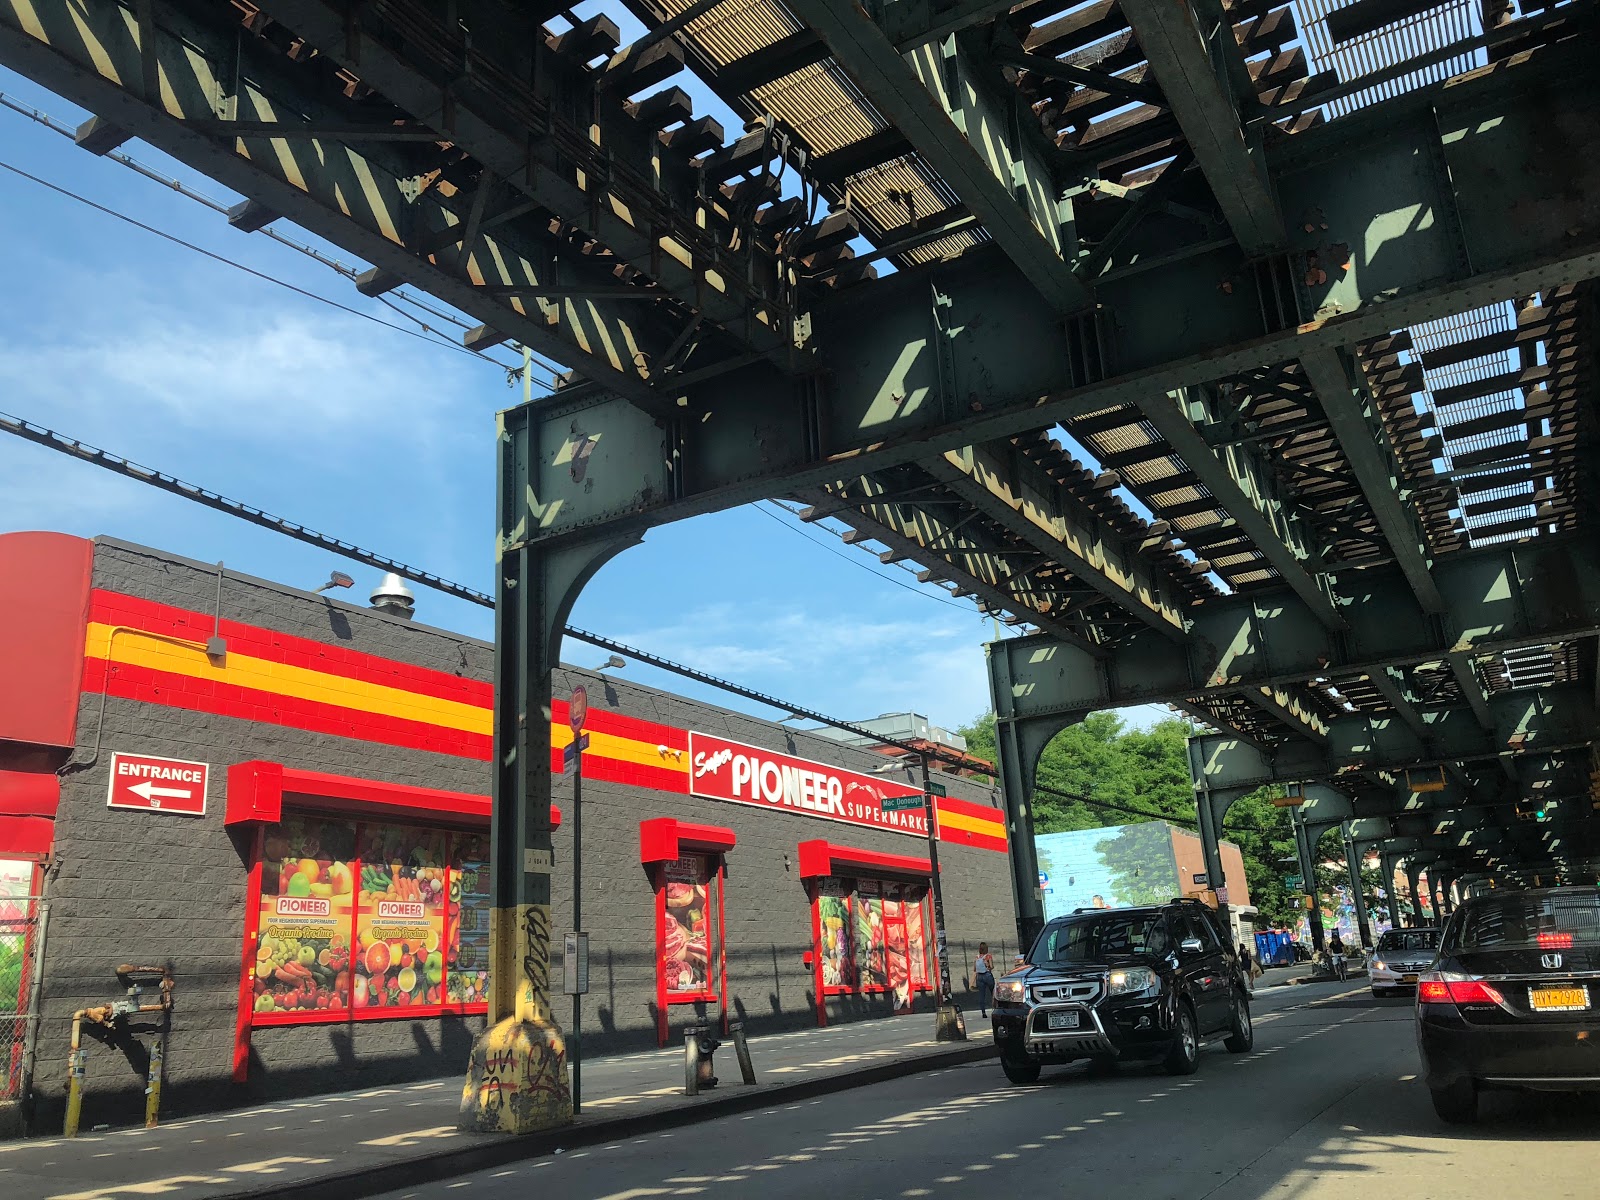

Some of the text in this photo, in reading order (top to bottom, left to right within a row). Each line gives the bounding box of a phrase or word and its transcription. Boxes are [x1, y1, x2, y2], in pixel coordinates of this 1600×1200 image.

[118, 762, 202, 783] ENTRANCE
[695, 748, 846, 817] Super PIONEER
[882, 796, 922, 807] Mac Donough
[848, 801, 929, 832] SUPERMARKE
[279, 899, 328, 913] PIONEER
[380, 902, 422, 915] PIONEER
[268, 925, 335, 941] Organic Produce
[372, 926, 429, 941] Organic Produce
